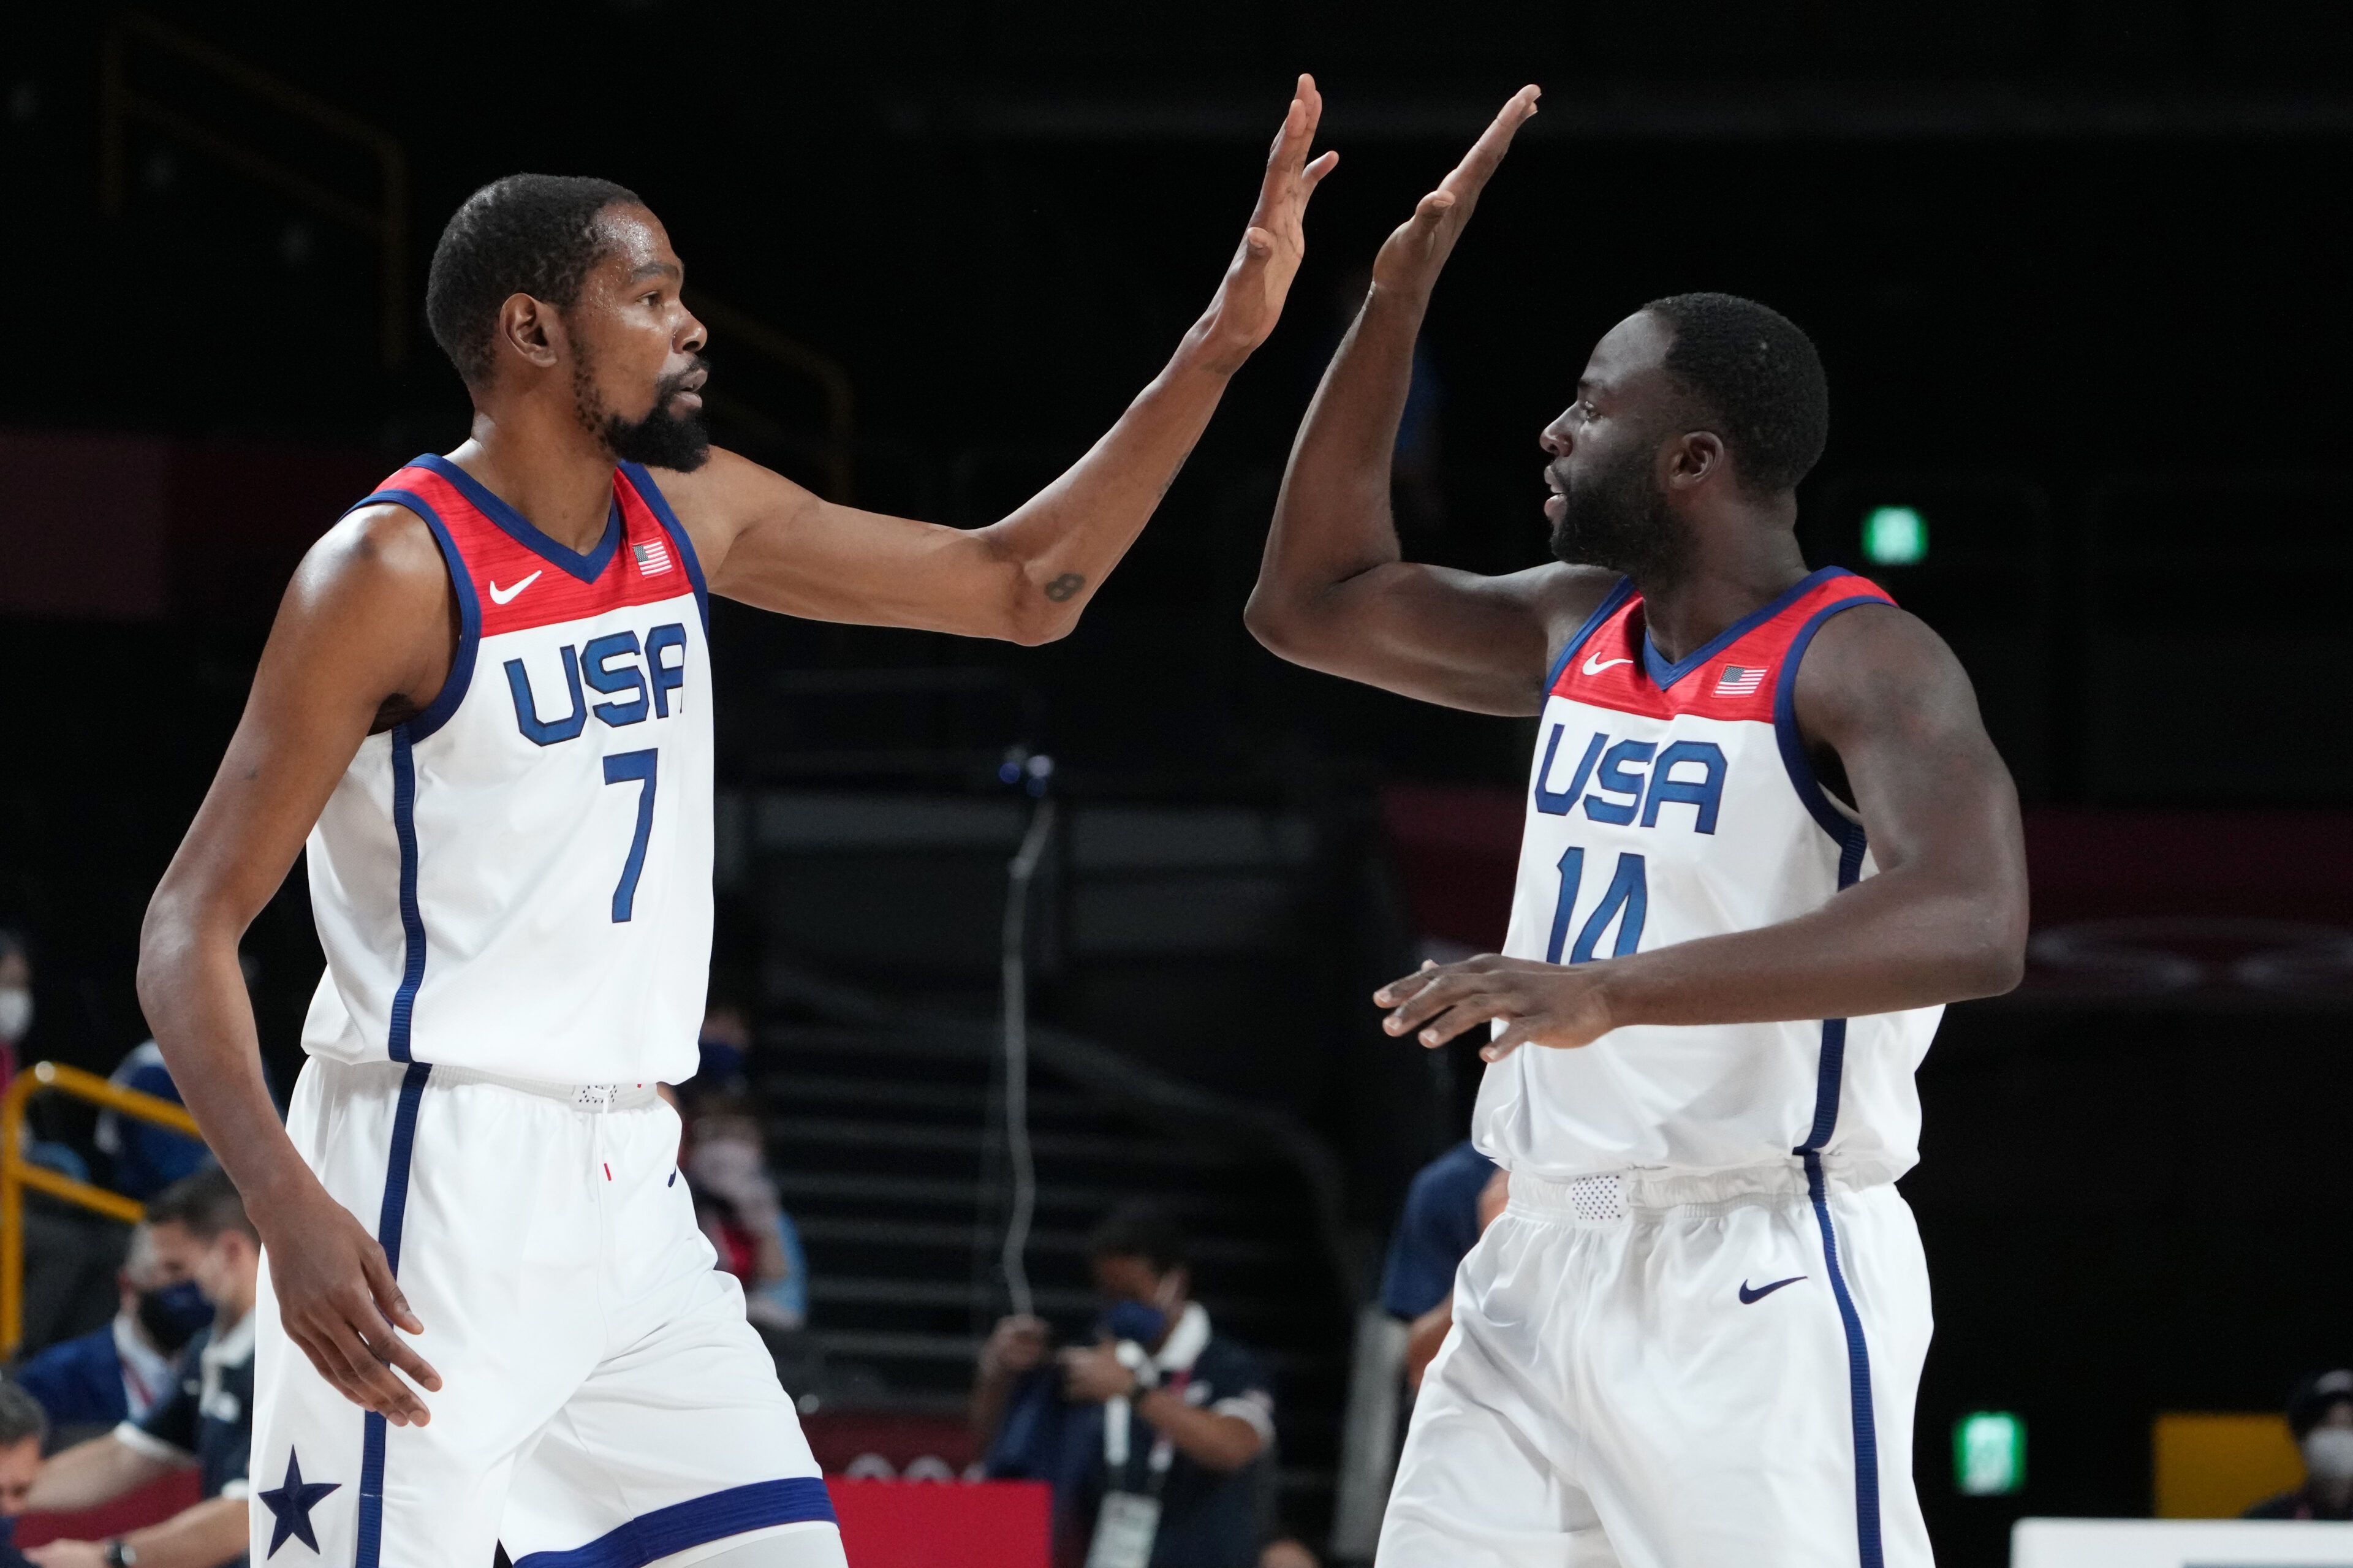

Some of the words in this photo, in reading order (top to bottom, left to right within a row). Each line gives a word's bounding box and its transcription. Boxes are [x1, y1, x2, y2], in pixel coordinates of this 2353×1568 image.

[503, 623, 687, 747] USA
[603, 748, 658, 923] 7
[1535, 724, 1727, 835] USA
[1546, 846, 1648, 965] 14
